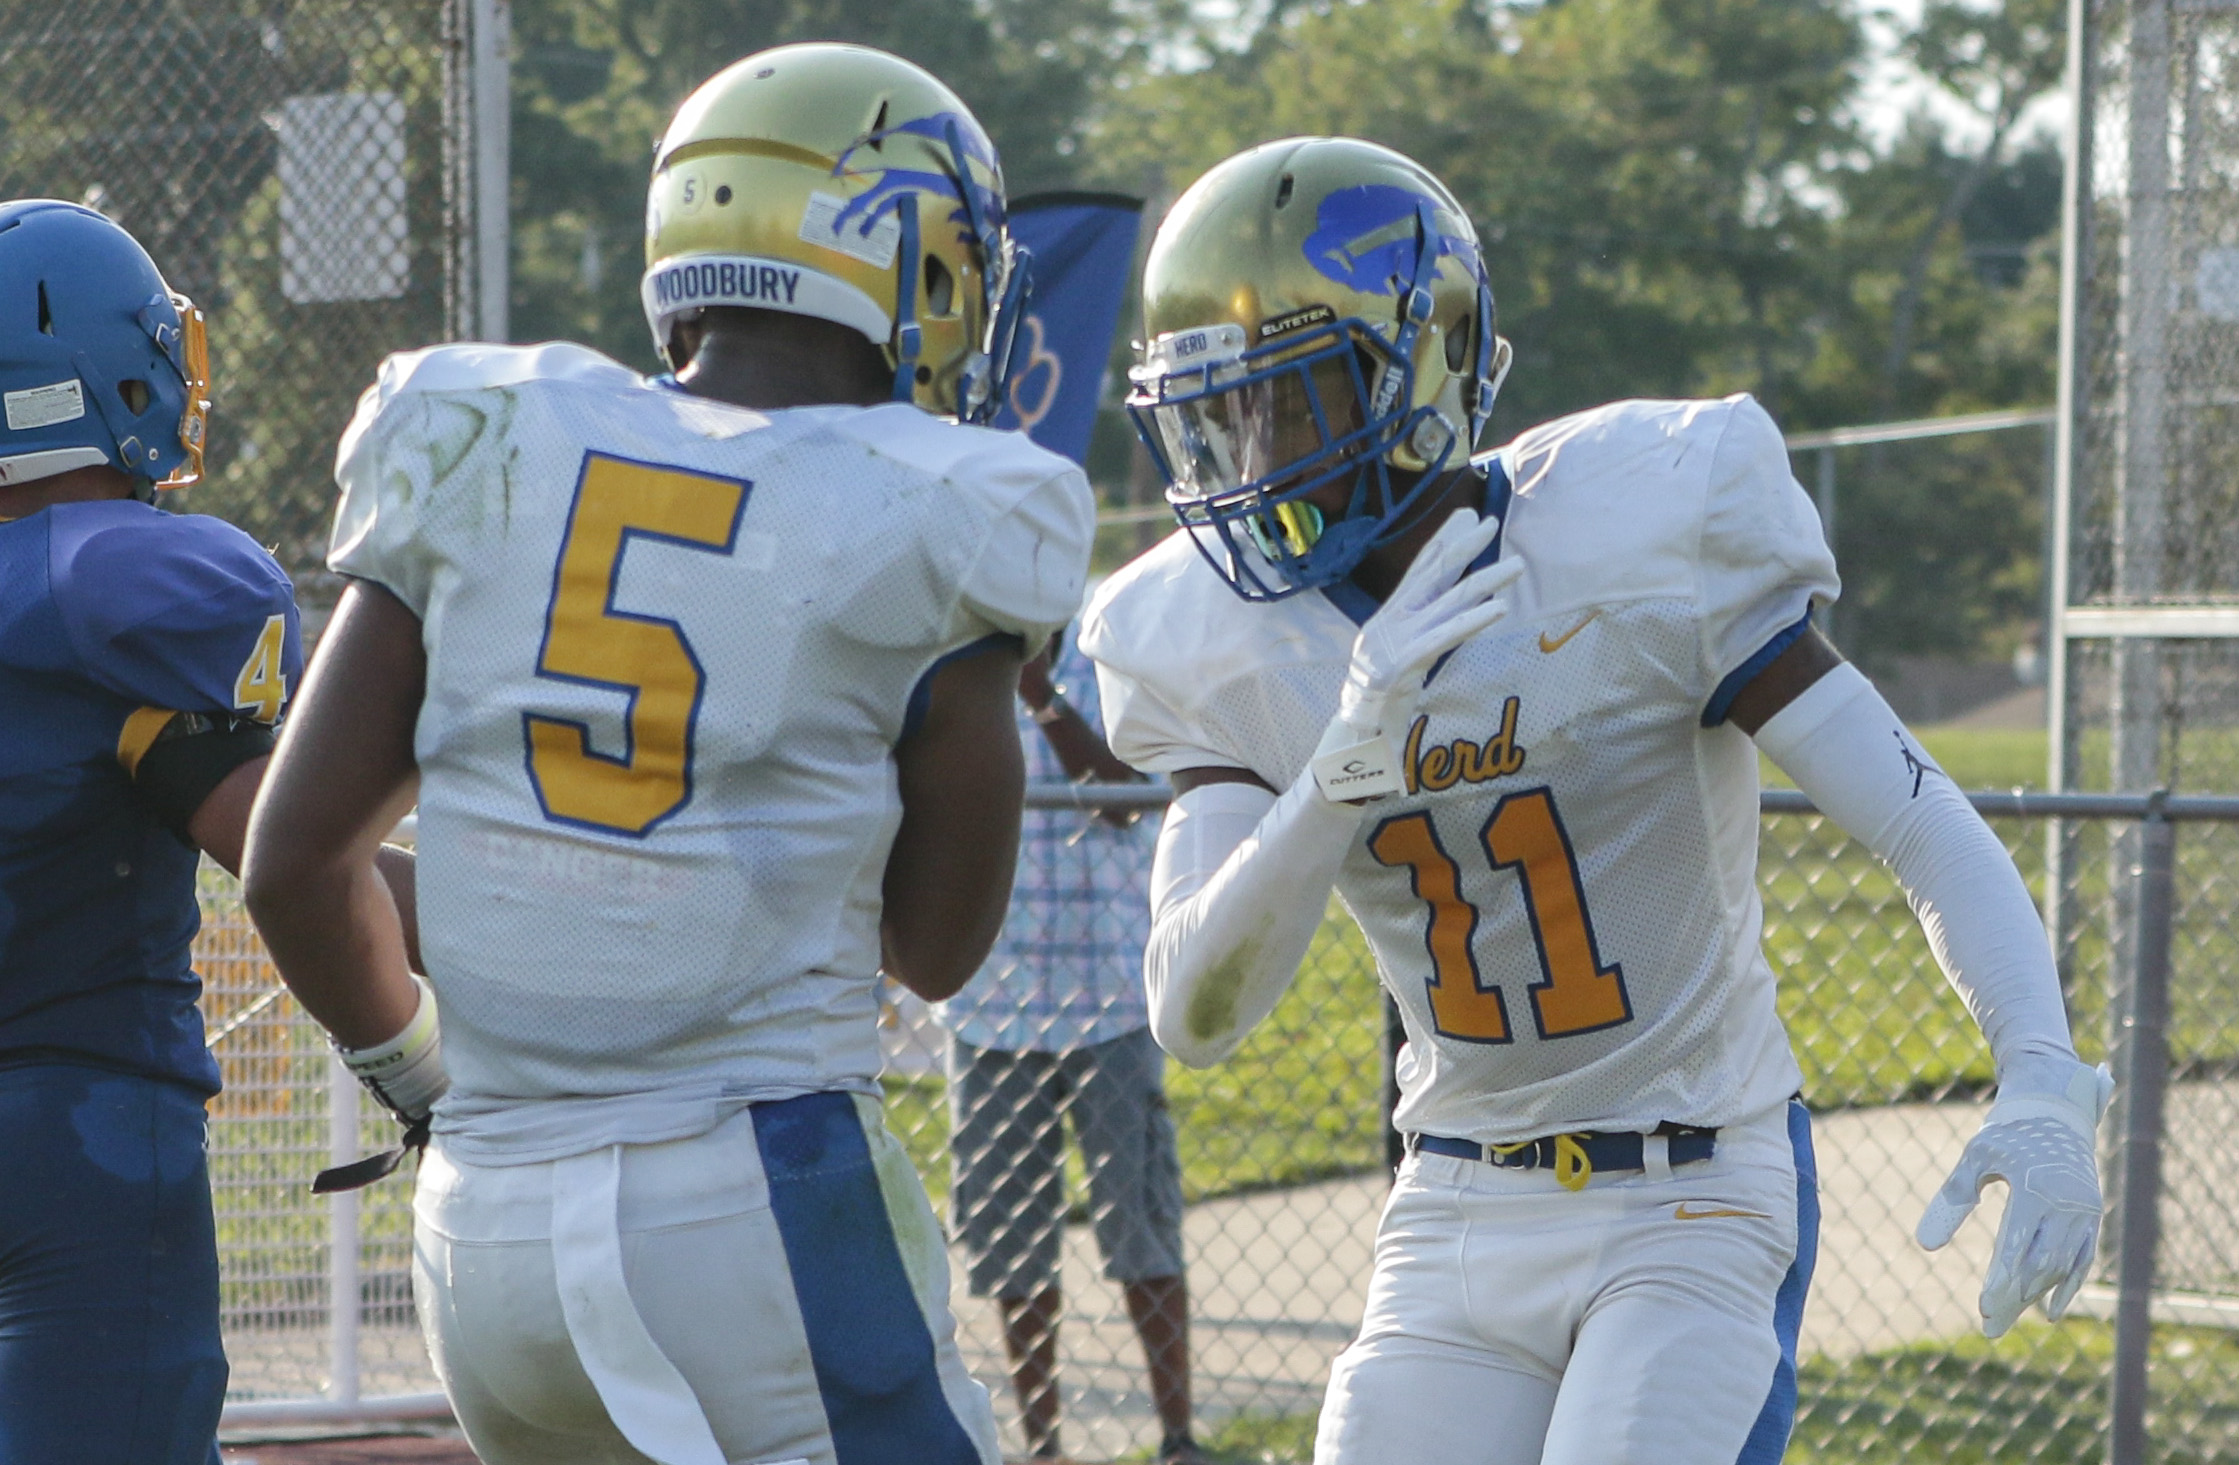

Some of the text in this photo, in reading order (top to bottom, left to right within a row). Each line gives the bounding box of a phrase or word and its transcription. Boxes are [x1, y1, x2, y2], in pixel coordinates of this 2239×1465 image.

[683, 179, 695, 205] 5
[655, 263, 801, 306] WOODBURY
[1262, 308, 1330, 336] ELITETEK
[1375, 366, 1404, 421] ddell
[522, 448, 755, 839] 5
[234, 613, 288, 726] 4
[1329, 770, 1385, 786] CUTTERS
[1366, 785, 1634, 1044] 11
